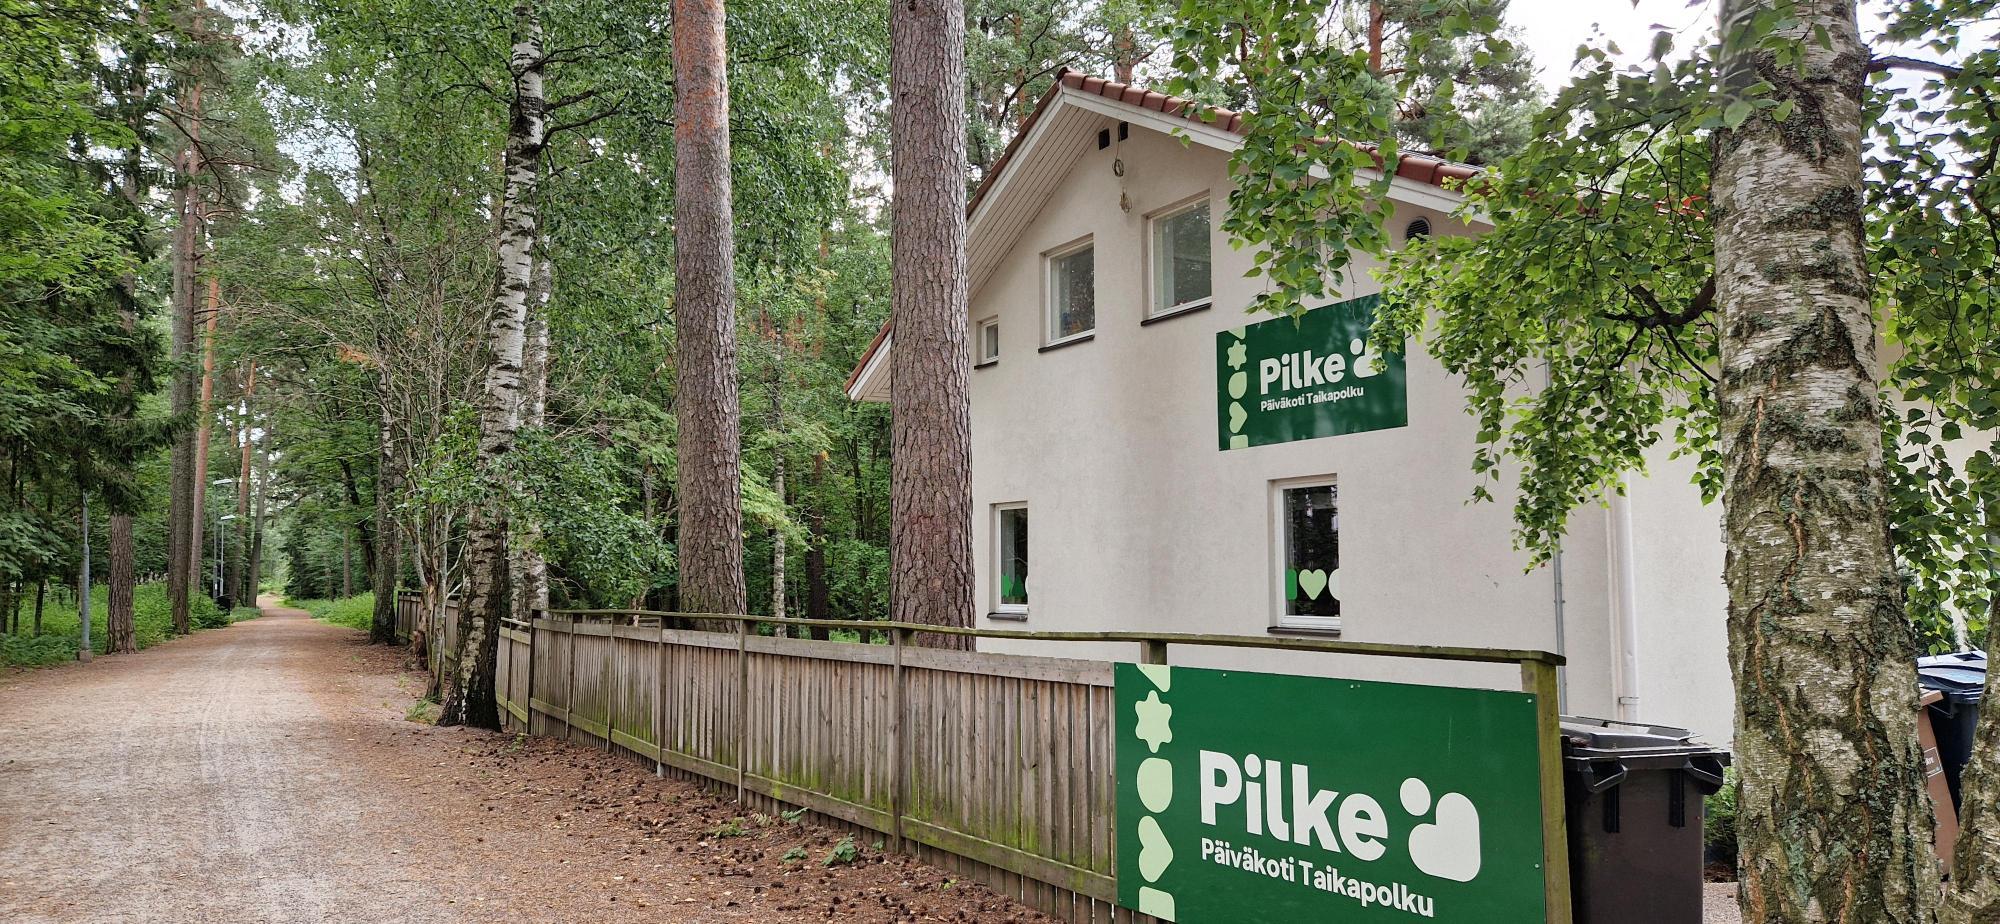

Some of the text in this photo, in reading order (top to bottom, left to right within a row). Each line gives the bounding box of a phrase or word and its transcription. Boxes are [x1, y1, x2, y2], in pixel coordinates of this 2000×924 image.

[1260, 350, 1346, 394] Pilke
[1260, 385, 1364, 412] Päiväkoti Taikapolku
[1200, 749, 1389, 862] Pilke
[1201, 837, 1434, 918] Päiväkoti Taikapolku
